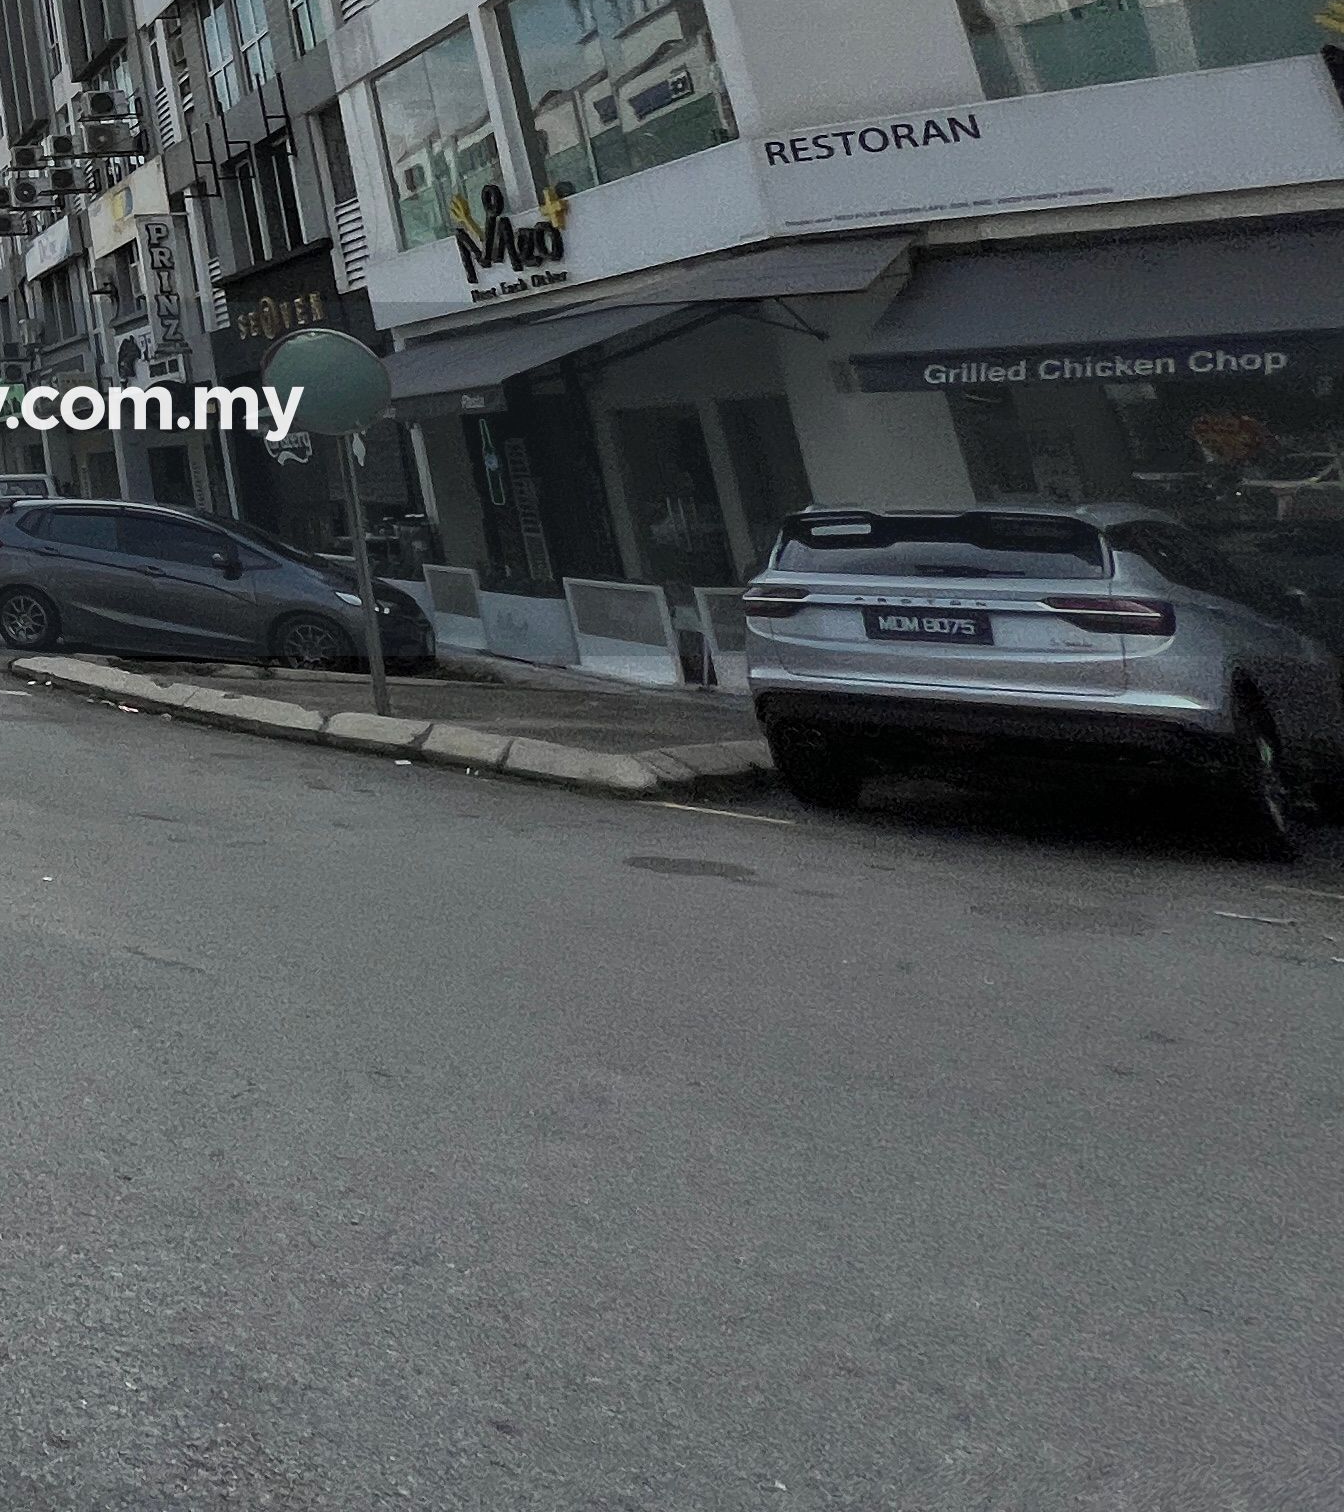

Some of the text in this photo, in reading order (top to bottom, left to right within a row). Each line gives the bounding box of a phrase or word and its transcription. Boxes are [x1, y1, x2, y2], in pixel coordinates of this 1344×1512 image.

[764, 113, 982, 167] RESTORAN
[145, 223, 183, 341] PRINZ
[924, 349, 1288, 386] Grilled Chicken Chop
